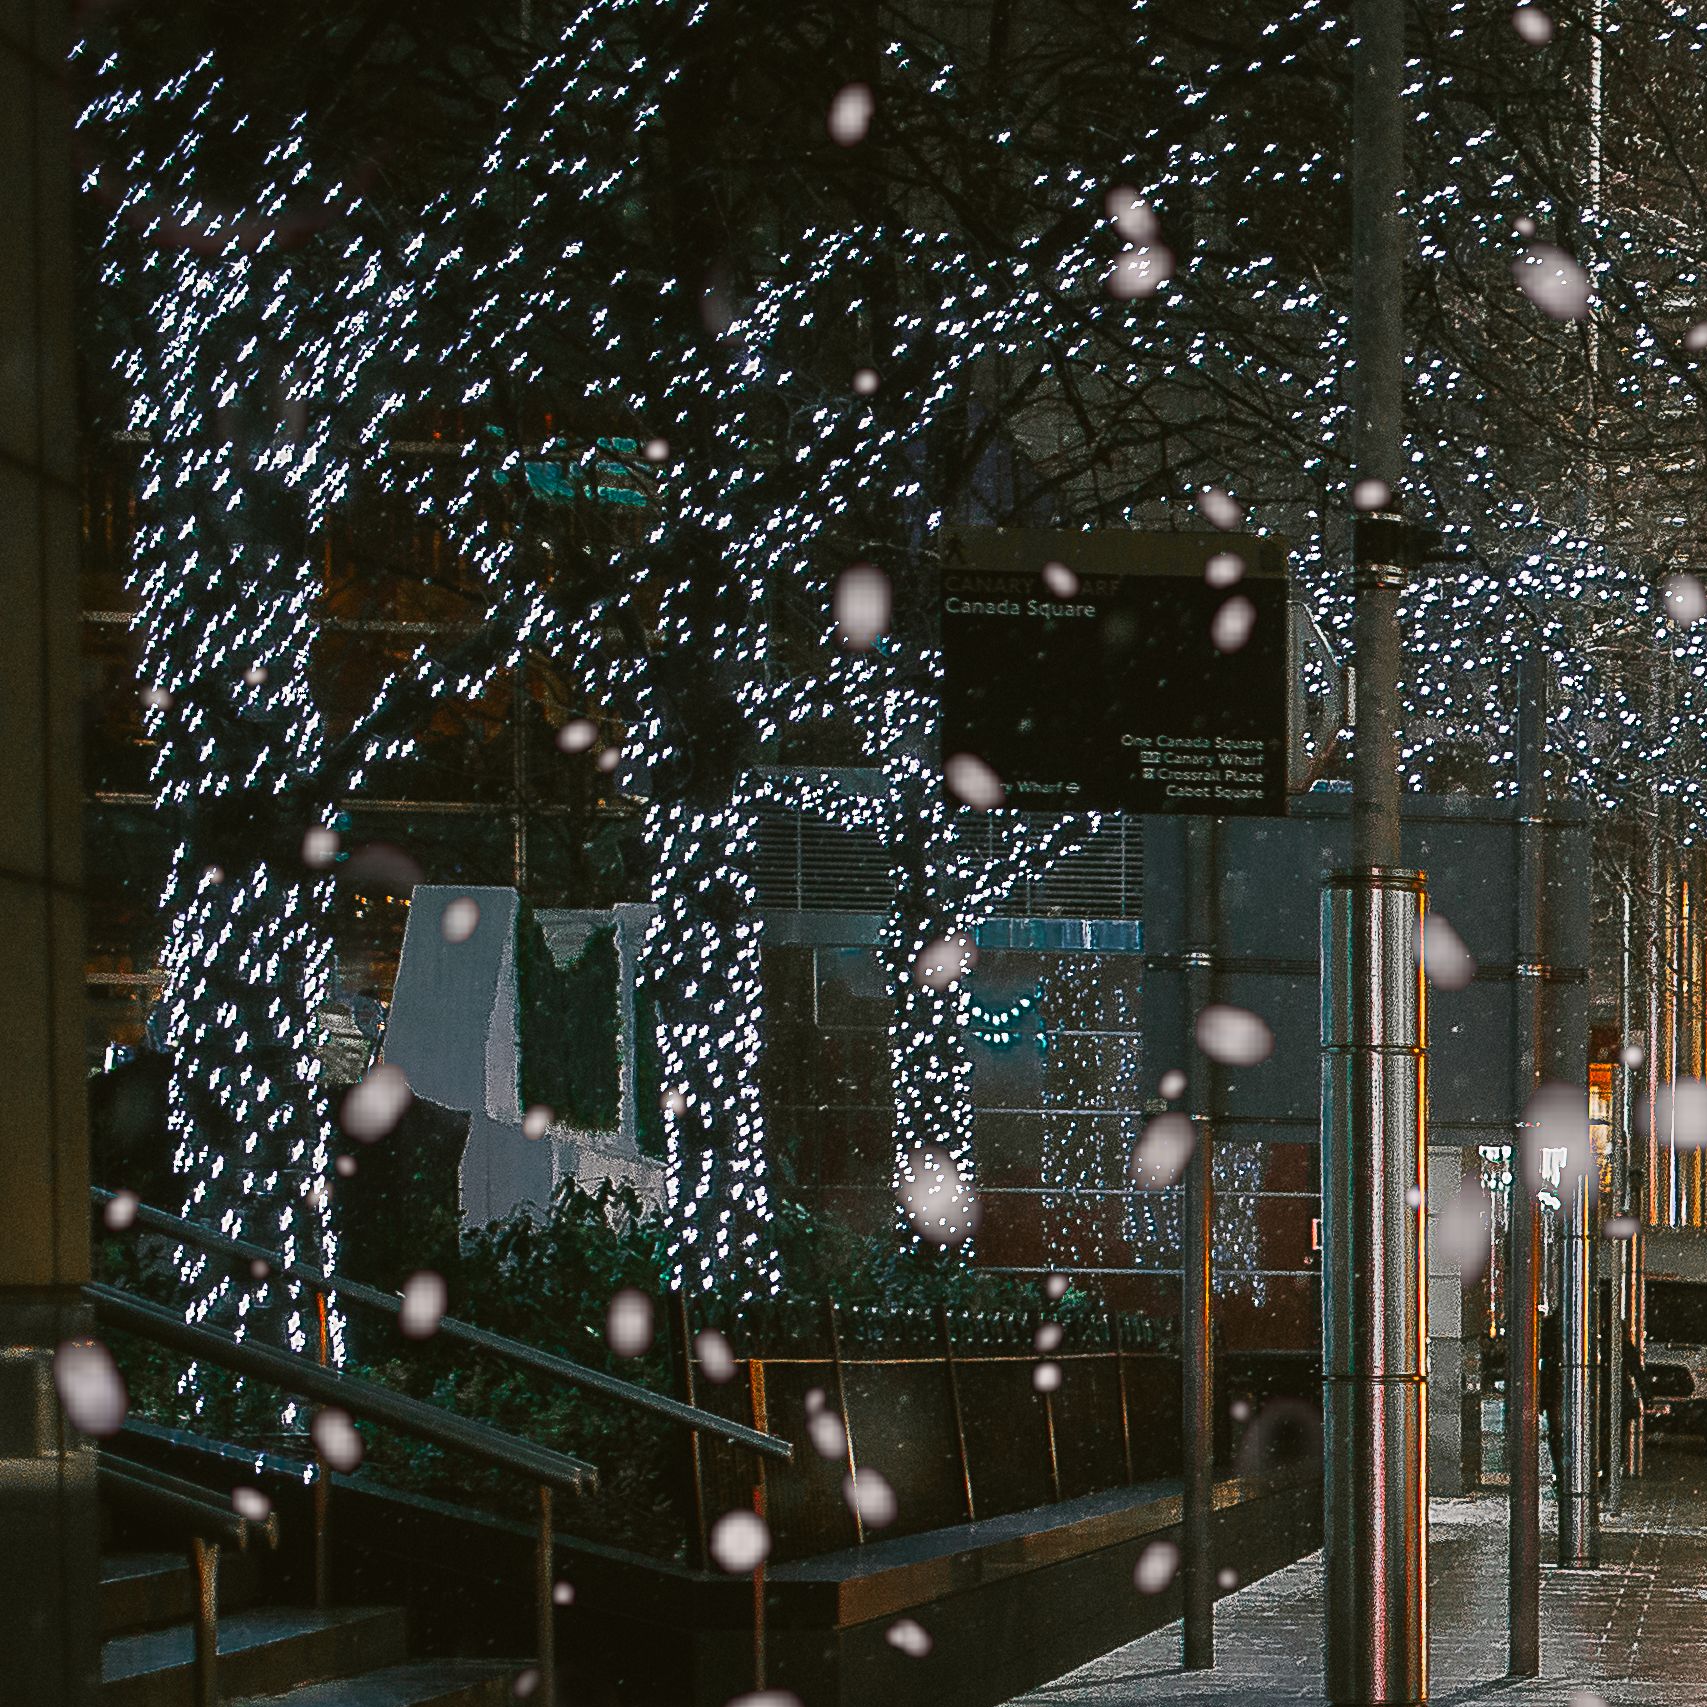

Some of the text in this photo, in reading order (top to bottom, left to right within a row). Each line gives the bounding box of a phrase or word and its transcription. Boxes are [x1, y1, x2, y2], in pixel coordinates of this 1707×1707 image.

[944, 597, 1097, 619] Canada Square
[1120, 733, 1265, 751] One Canada Square
[1163, 751, 1216, 768] Canary
[1218, 752, 1265, 766] Wharf
[1156, 768, 1265, 783] Crossrail Place
[1016, 780, 1064, 794] Wharf
[1165, 784, 1265, 800] Cabot Square
